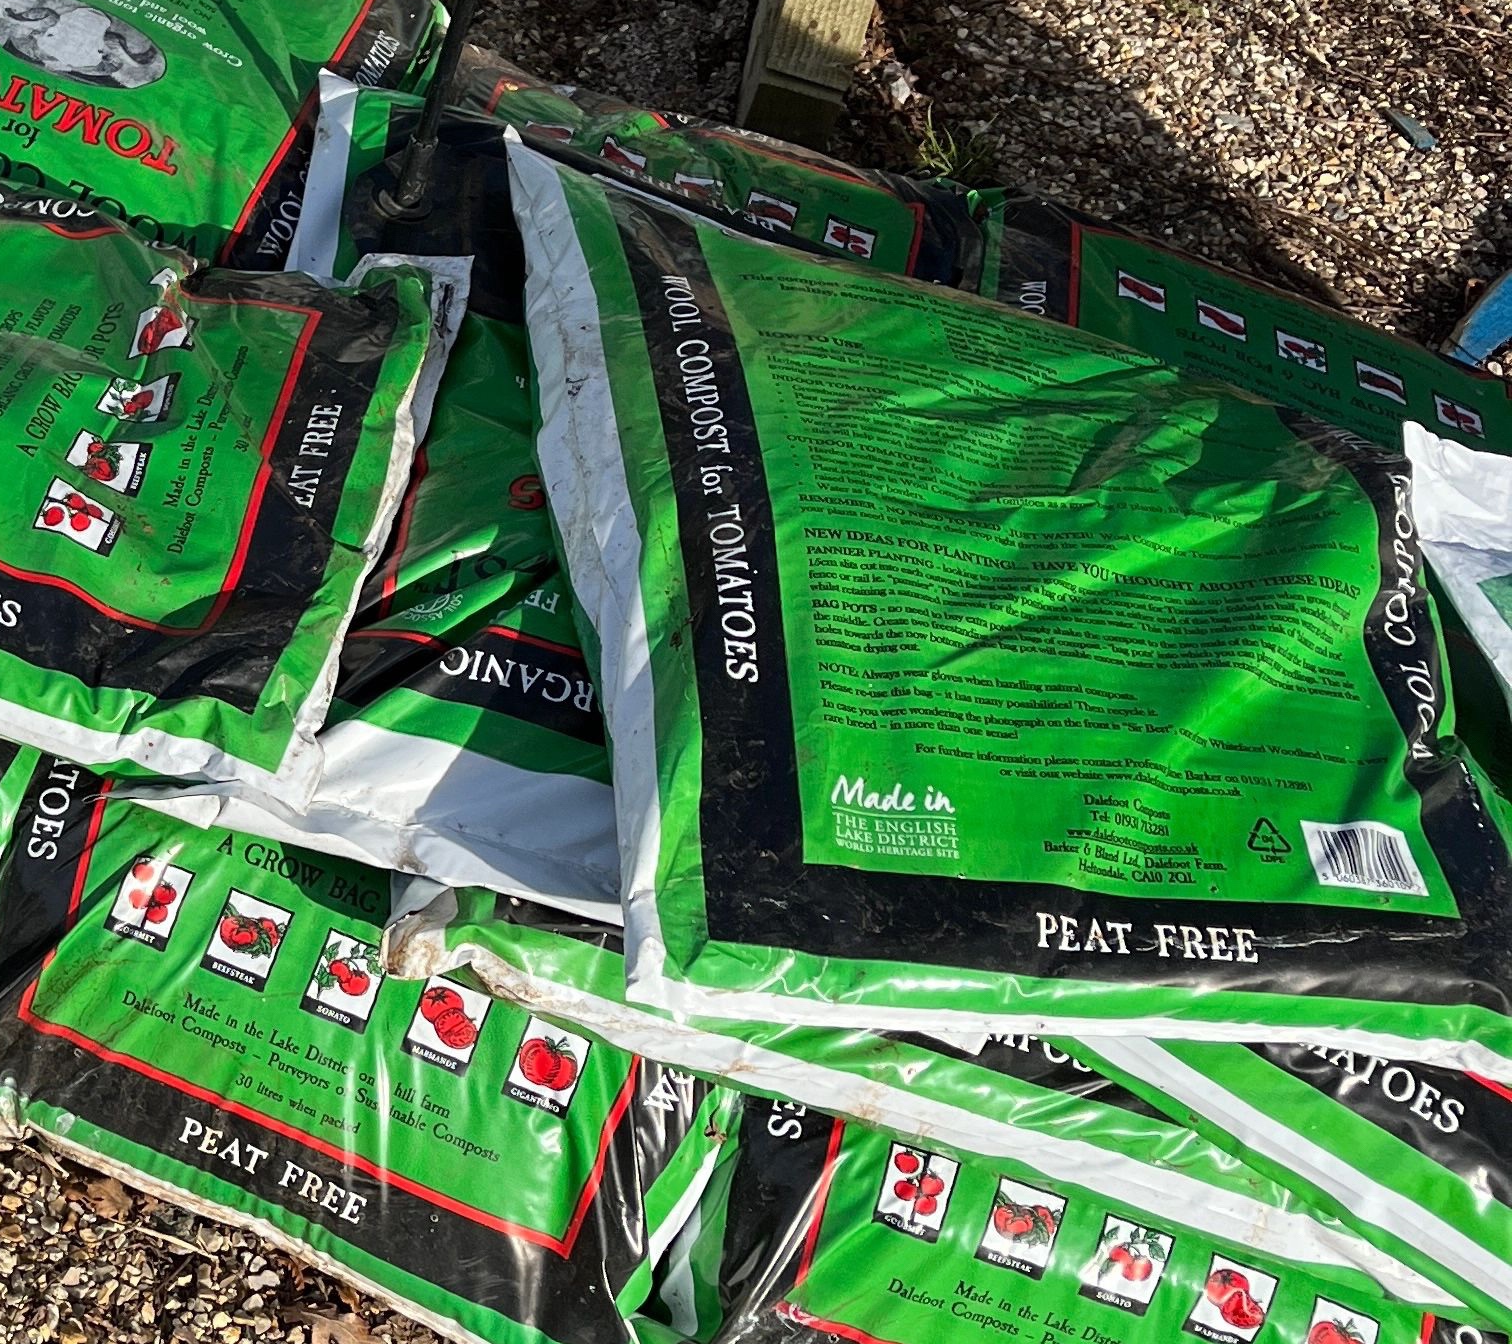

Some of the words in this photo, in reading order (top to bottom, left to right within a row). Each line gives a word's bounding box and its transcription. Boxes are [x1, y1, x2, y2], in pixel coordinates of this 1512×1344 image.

[139, 1, 168, 17] and
[143, 10, 197, 41] organic
[170, 13, 208, 36] wool
[201, 39, 243, 69] Grow
[1, 118, 40, 148] for
[94, 301, 125, 346] POTS
[660, 274, 690, 333] WOOL
[53, 368, 84, 400] BAG
[675, 338, 730, 455] COMPOST
[25, 392, 64, 440] GROW
[299, 404, 343, 457] FREE
[16, 442, 39, 458] A
[288, 465, 323, 509] EAT
[699, 463, 733, 496] for
[167, 511, 196, 554] Dalefoot
[184, 446, 215, 507] Composts
[804, 527, 841, 540] NEW
[846, 529, 894, 546] IDEAS
[897, 537, 930, 553] FOR
[706, 503, 759, 685] TOMATOES
[1033, 560, 1078, 573] HAVE
[1079, 561, 1109, 581] YOU
[1112, 571, 1194, 592] THOUGHT
[1199, 579, 1256, 594] ABOUT
[1260, 575, 1318, 588] THESE
[1318, 574, 1362, 600] IDEAS?
[440, 646, 595, 713] RGANIC
[831, 774, 916, 811] Made
[924, 785, 956, 814] in
[832, 812, 868, 830] THE
[875, 819, 957, 836] ENGLISH
[836, 825, 873, 843] LAKE
[878, 834, 959, 849] DISTRICT
[836, 837, 874, 853] WORLD
[877, 846, 934, 857] HERITAGE
[936, 848, 960, 860] SITE
[216, 833, 234, 856] A
[243, 842, 324, 889] GROW
[328, 878, 381, 913] BAG
[1036, 912, 1132, 954] PEAT
[1154, 923, 1259, 964] FREE
[211, 961, 255, 985] BEEFSTEAK
[122, 990, 176, 1024] Dalefoot
[181, 1016, 247, 1054] Composts
[178, 1117, 268, 1175] PEAT
[278, 1161, 368, 1224] FREE
